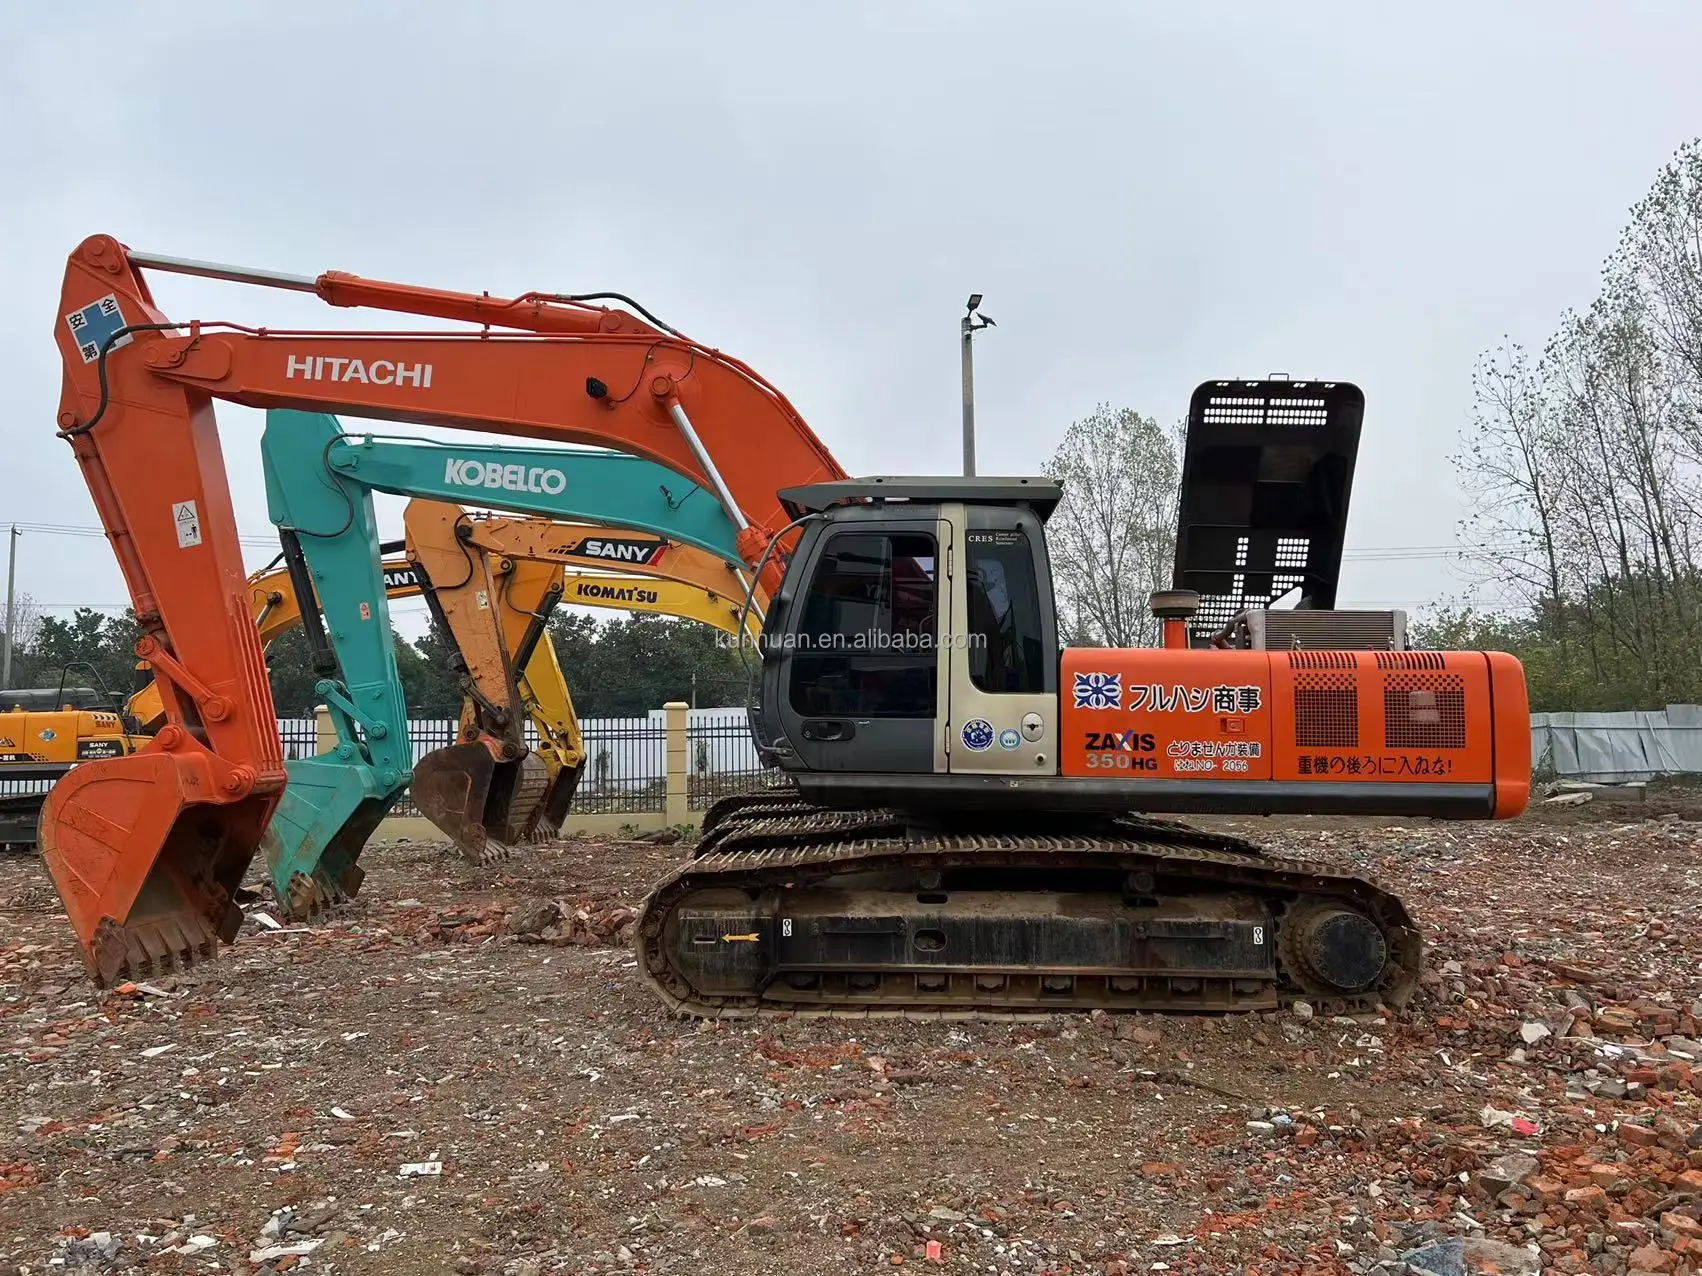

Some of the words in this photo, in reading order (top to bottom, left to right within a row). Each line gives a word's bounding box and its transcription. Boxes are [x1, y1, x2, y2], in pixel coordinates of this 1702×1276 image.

[286, 354, 433, 388] HITACHI
[444, 458, 567, 495] KOBELCO
[585, 541, 650, 562] SANY
[383, 571, 419, 586] ANY
[577, 583, 658, 604] KOMATSU
[1128, 683, 1262, 713] フルハシ商事
[1084, 729, 1156, 751] ZAXIS
[1086, 753, 1158, 771] 350HG
[1223, 760, 1249, 772] 2056
